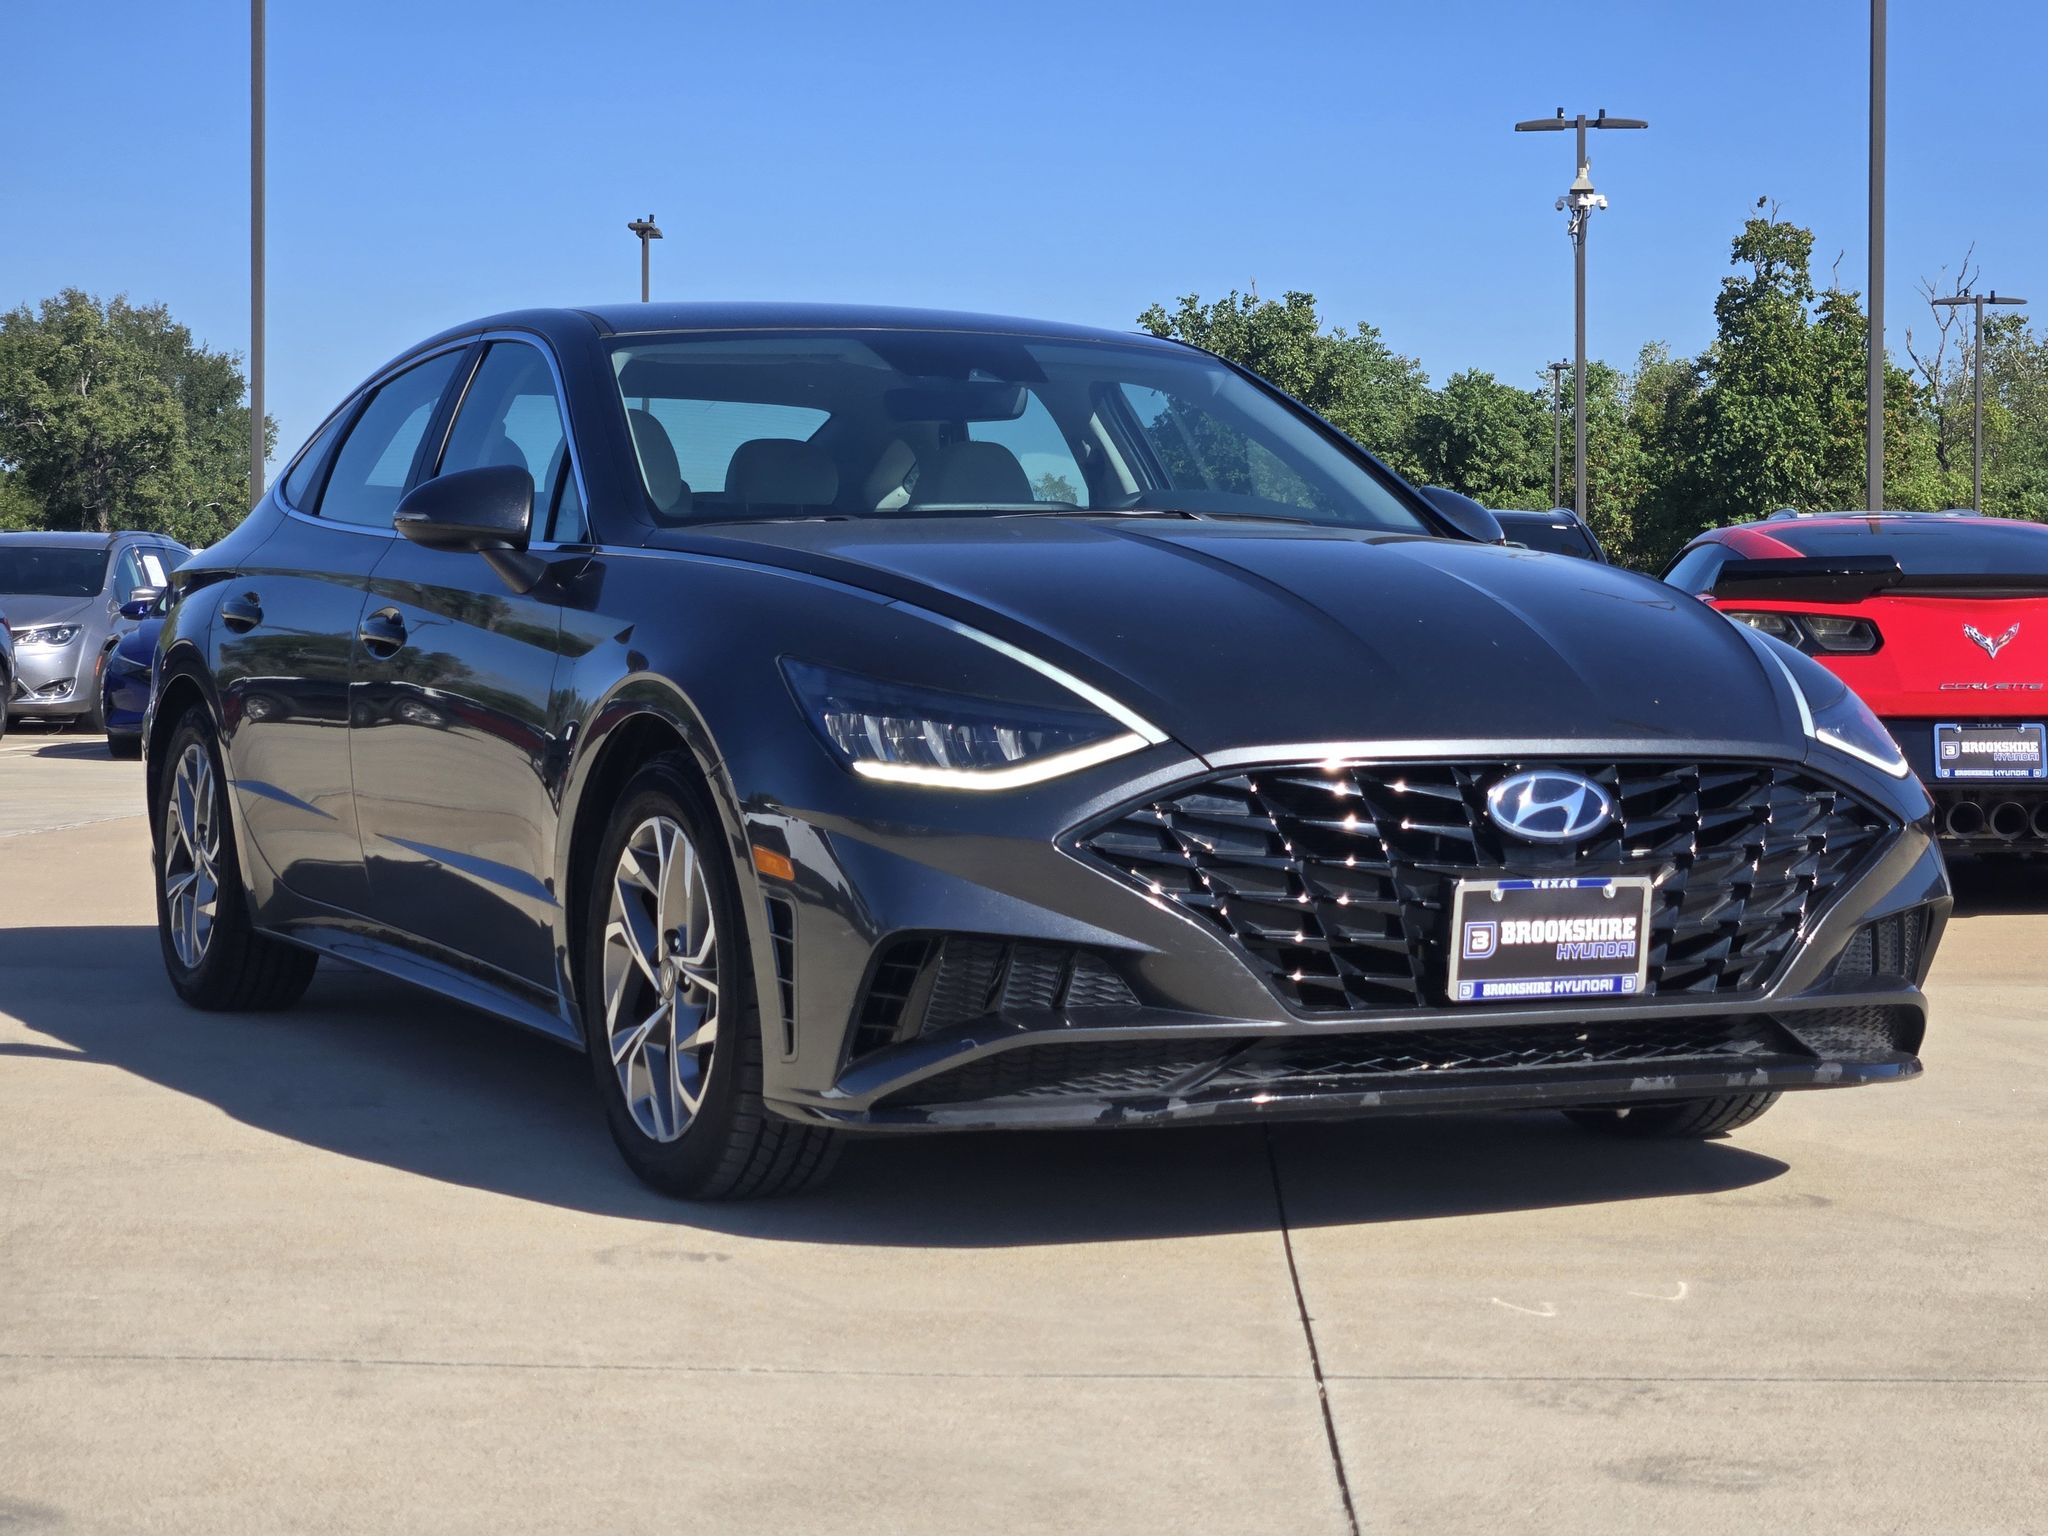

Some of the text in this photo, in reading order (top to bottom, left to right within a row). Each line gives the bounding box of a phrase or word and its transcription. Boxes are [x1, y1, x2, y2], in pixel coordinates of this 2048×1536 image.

[1961, 741, 2039, 753] BROOKSHIRE
[1993, 752, 2039, 761] HYUNDAI
[1531, 879, 1578, 889] TEXAS
[1500, 917, 1637, 944] BROOKSHIRE
[1556, 941, 1636, 960] HYUNDAI
[1482, 981, 1552, 997] BROOKSHIRE
[1554, 978, 1614, 993] HYUNDAI
